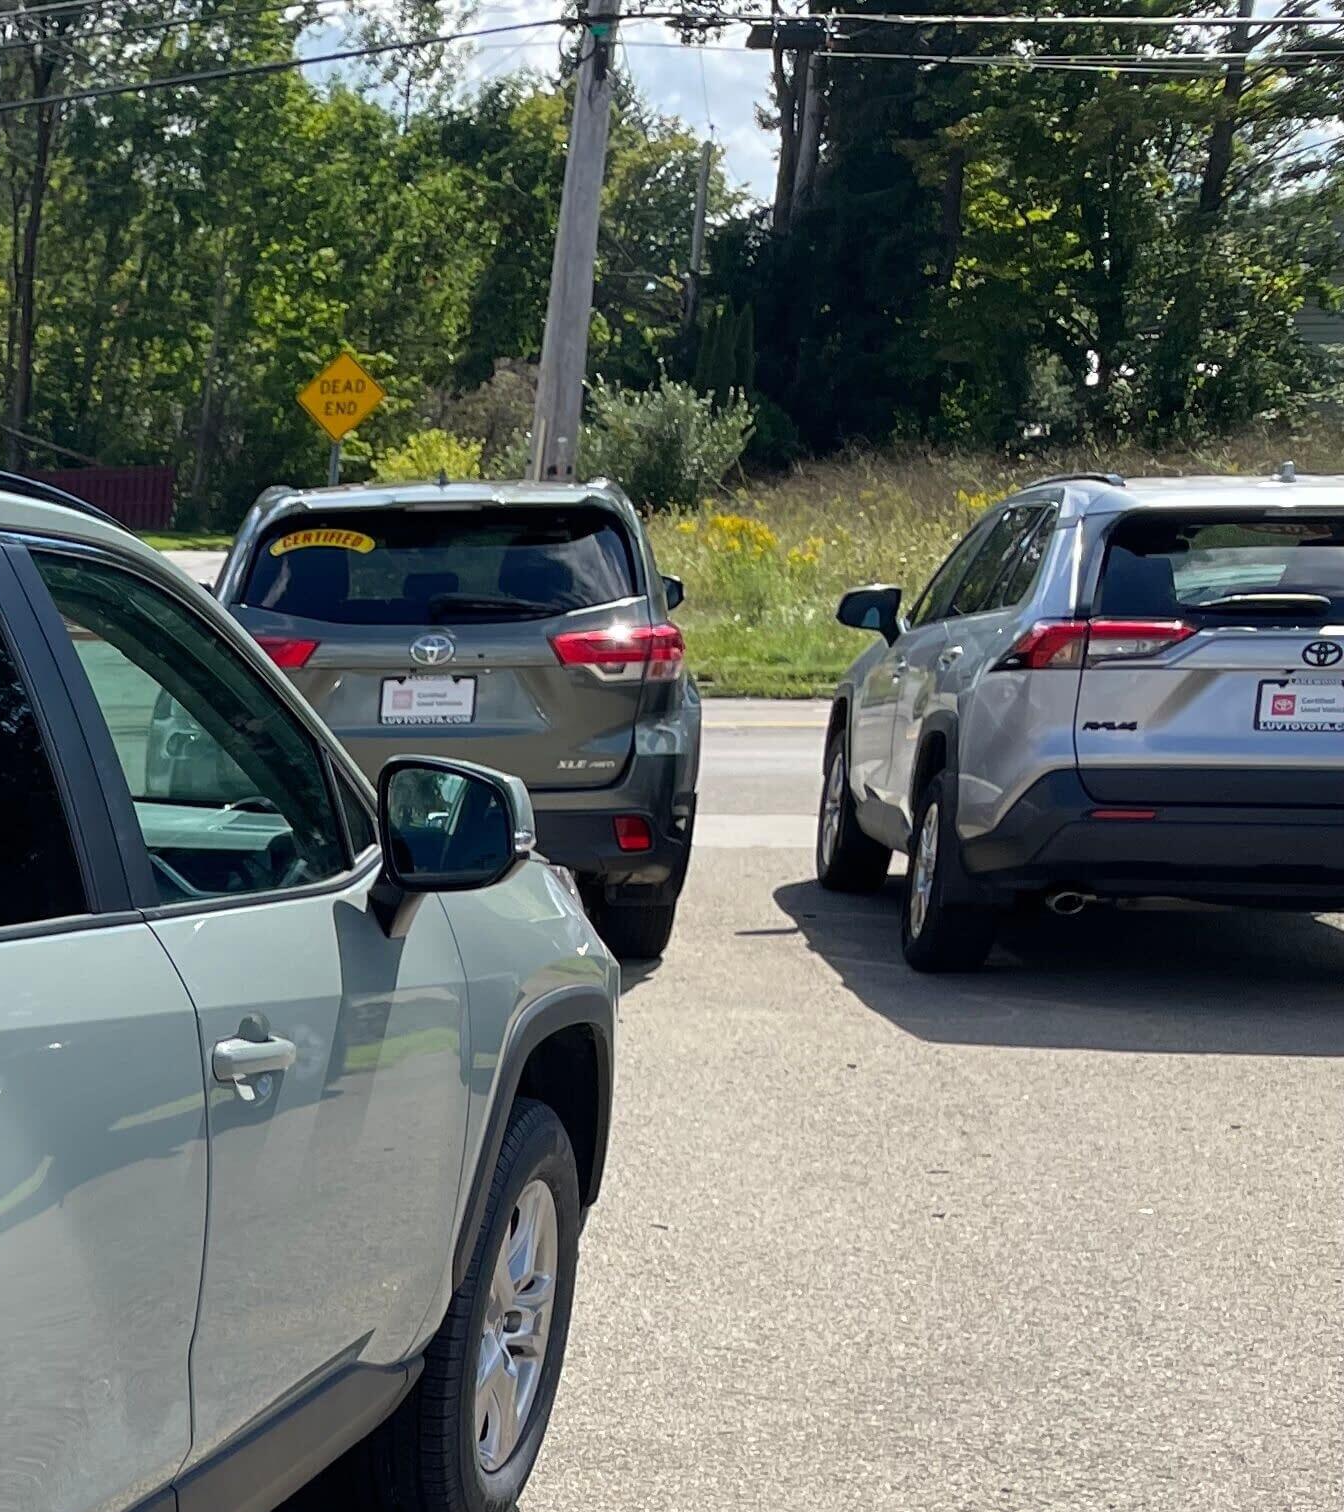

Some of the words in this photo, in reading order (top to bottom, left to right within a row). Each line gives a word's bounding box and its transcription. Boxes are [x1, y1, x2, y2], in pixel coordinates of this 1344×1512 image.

[320, 379, 366, 394] DEAD
[325, 401, 357, 416] END
[283, 530, 364, 549] CERTIFIED
